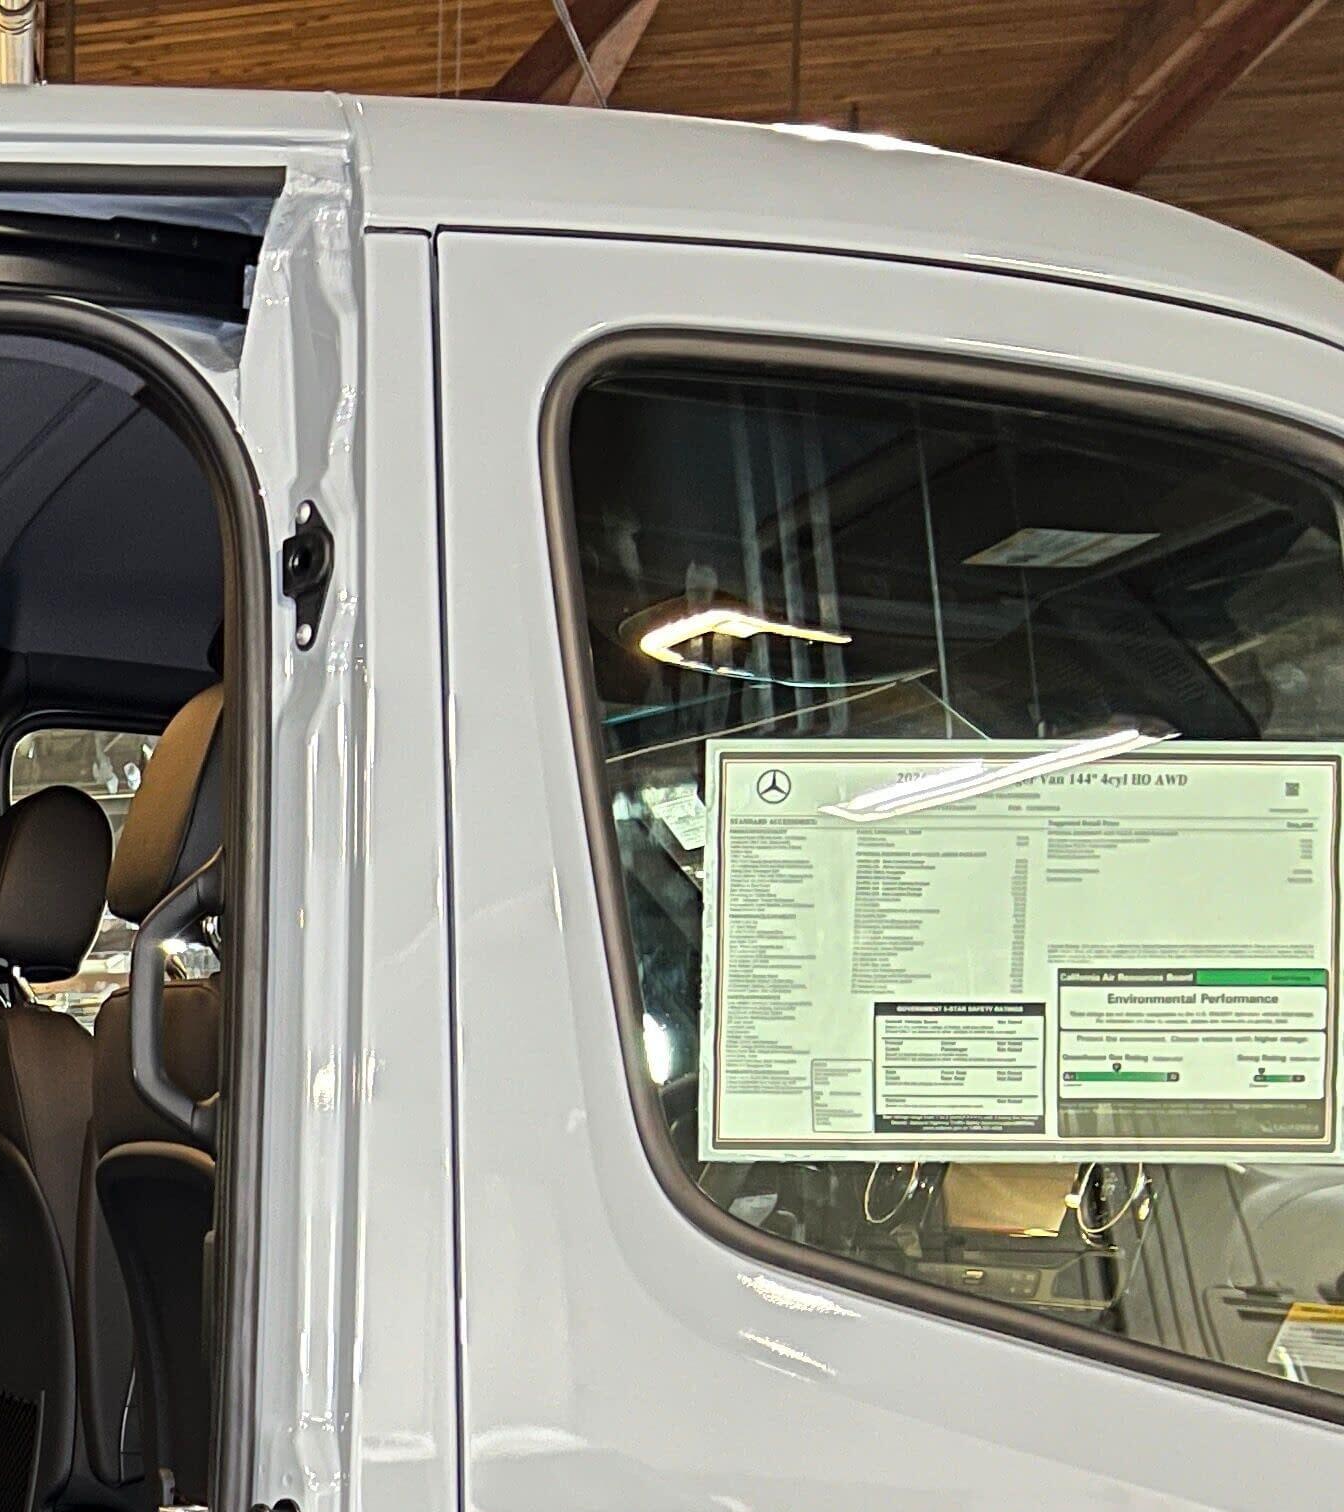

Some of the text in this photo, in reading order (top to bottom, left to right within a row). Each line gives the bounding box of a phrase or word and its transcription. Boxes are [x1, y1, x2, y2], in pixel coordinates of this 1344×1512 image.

[1040, 774, 1065, 785] Van
[1069, 773, 1098, 785] 144"
[1101, 773, 1128, 788] 4cyl
[1155, 774, 1188, 786] AWD
[1107, 993, 1279, 1004] Environmental Performance
